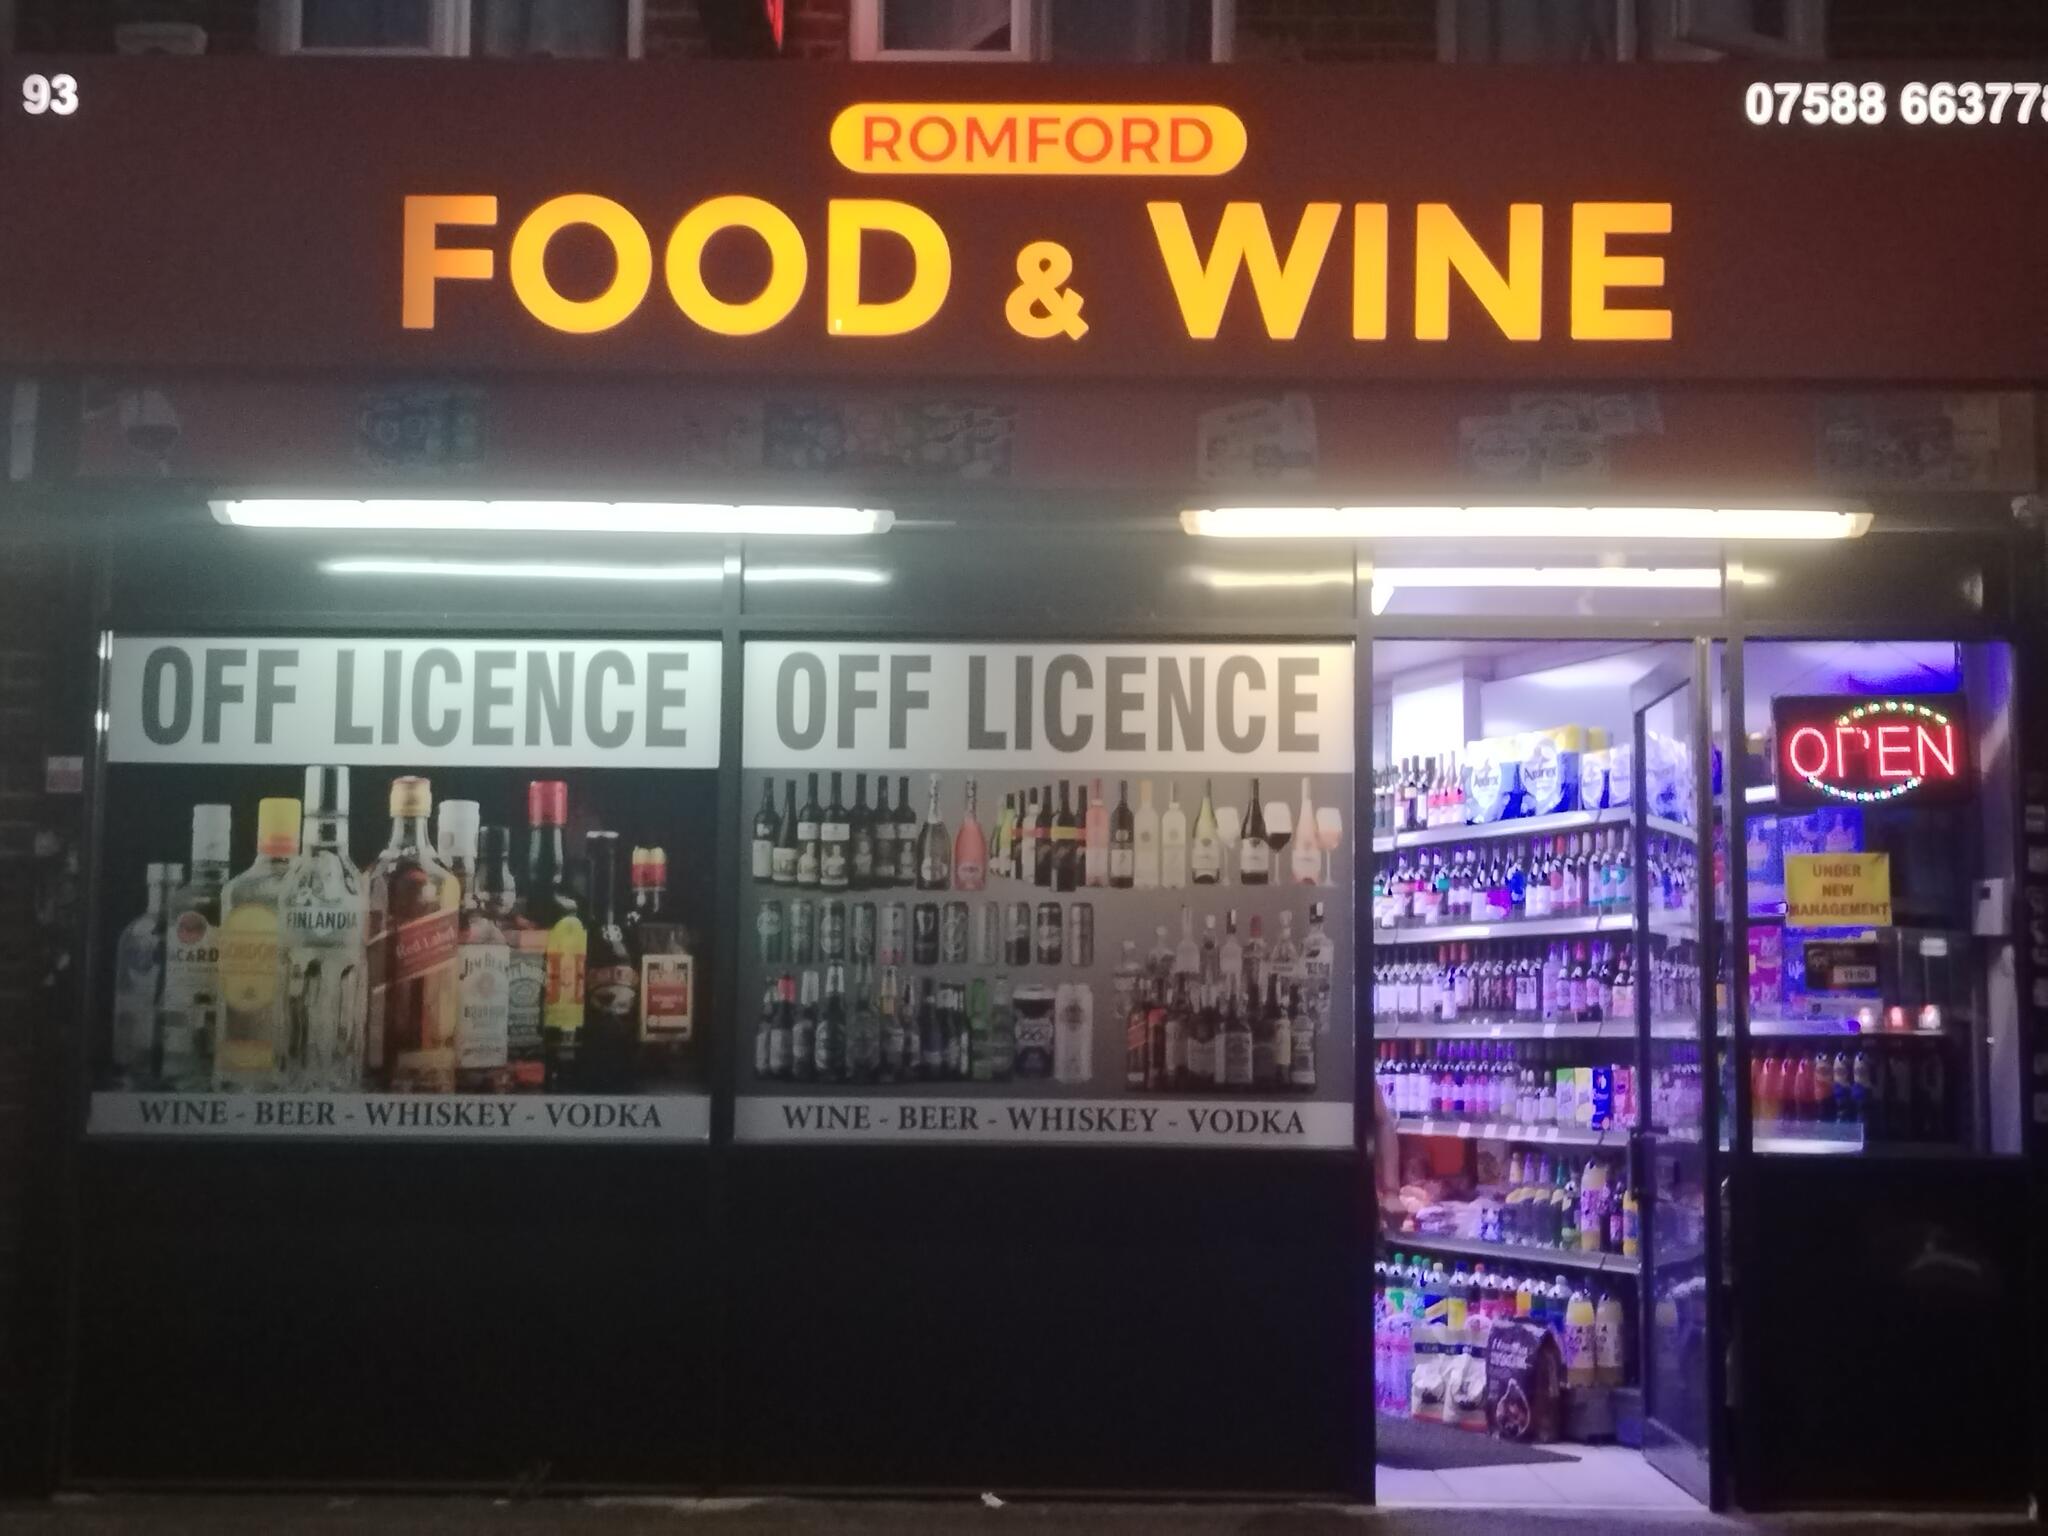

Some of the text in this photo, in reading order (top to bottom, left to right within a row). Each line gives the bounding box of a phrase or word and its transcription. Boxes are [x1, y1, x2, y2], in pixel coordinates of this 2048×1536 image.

[22, 74, 79, 116] 93
[1745, 82, 2048, 125] 07588 66377
[863, 115, 1214, 164] ROMFORD
[402, 193, 1673, 341] FOOD & WINE
[142, 645, 690, 749] OFF LICENCE
[775, 651, 1320, 754] OFF LICENCE
[1790, 723, 1956, 778] OPEN
[1812, 863, 1862, 878] UNDER
[1821, 883, 1855, 897] NEW
[286, 911, 357, 930] FINLANDIA
[1788, 901, 1889, 917] MANAGEMENT
[139, 1101, 228, 1125] WINE
[254, 1101, 335, 1126] BEER
[365, 1102, 517, 1127] WHISKEY
[545, 1103, 662, 1128] VODKA
[782, 1105, 871, 1130] WINE
[897, 1106, 979, 1131] BEER
[1007, 1107, 1159, 1133] WHISKEY
[1187, 1109, 1306, 1135] VODKA
